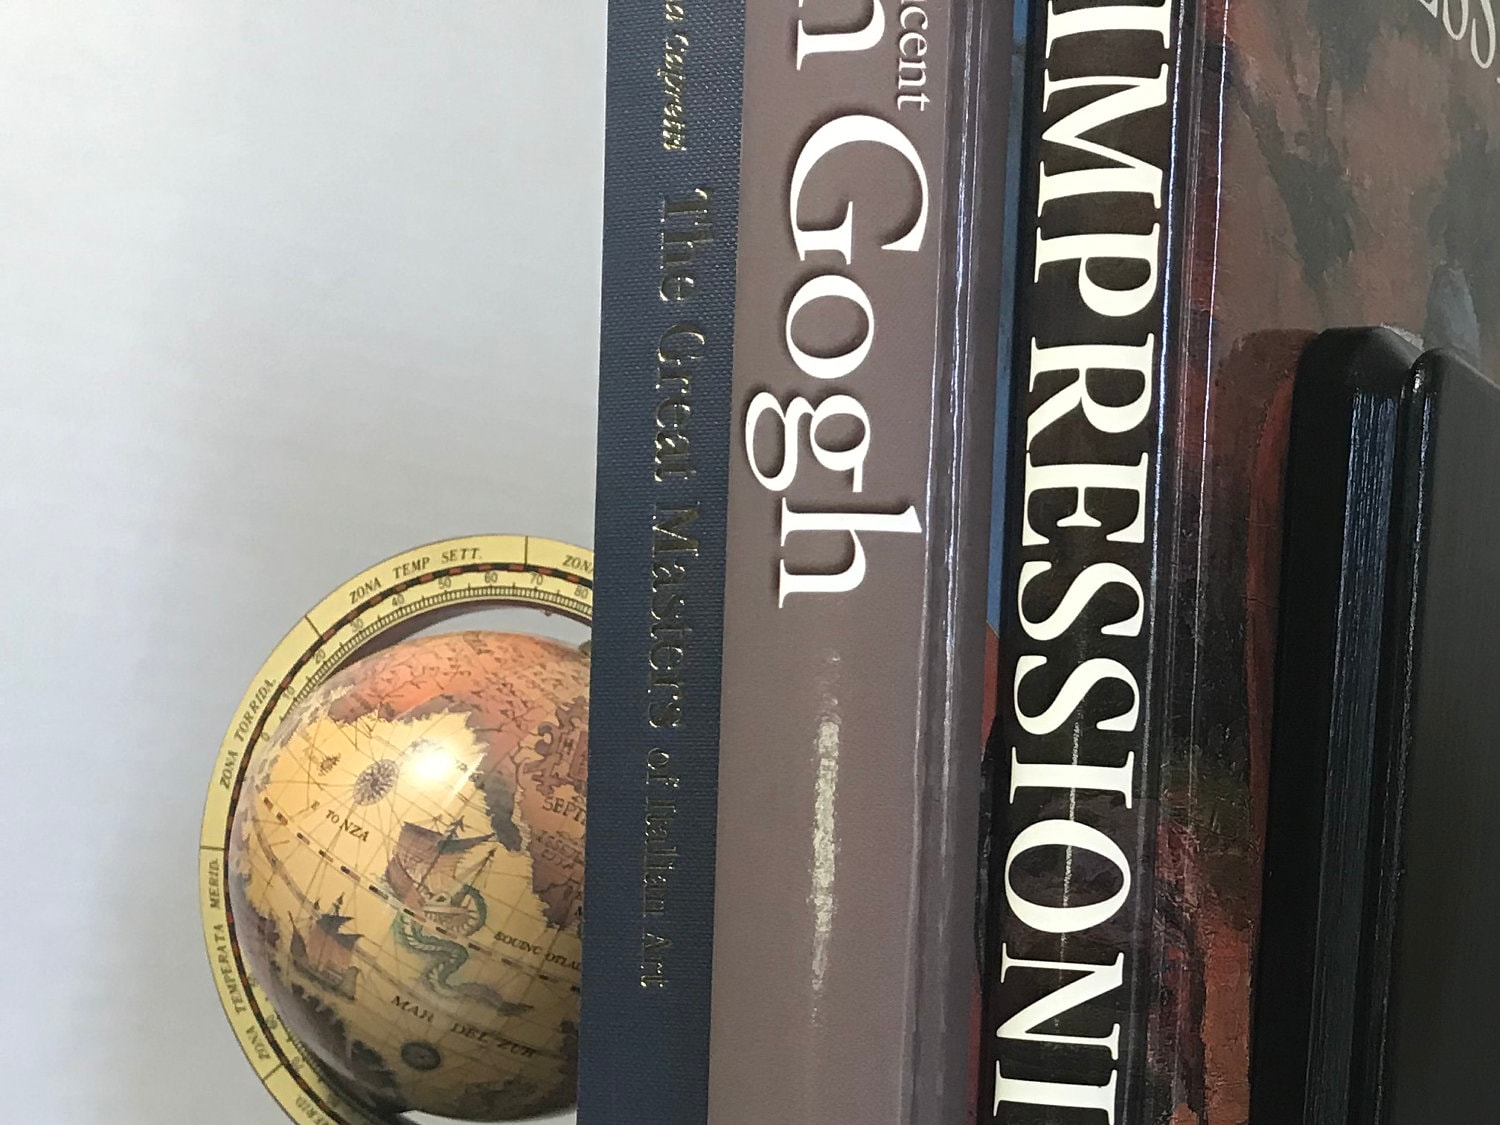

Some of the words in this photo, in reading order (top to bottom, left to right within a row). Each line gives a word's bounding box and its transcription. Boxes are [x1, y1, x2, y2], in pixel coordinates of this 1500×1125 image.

[897, 0, 931, 112] cent
[660, 187, 714, 303] The
[653, 323, 706, 484] Great
[744, 113, 930, 609] Gogh
[314, 650, 326, 664] 20
[350, 618, 364, 632] 30
[391, 594, 405, 607] 40
[438, 577, 451, 589] 50
[484, 572, 498, 584] 60
[530, 573, 544, 585] 70
[574, 585, 588, 599] 80
[349, 577, 382, 604] ZONA
[392, 556, 431, 579] TEMP
[648, 500, 701, 729] Masters
[220, 750, 238, 790] ZONA
[542, 796, 588, 827] SEPT
[646, 747, 680, 787] of
[643, 798, 679, 917] Italian
[640, 932, 673, 989] Art
[392, 995, 434, 1024] MAR
